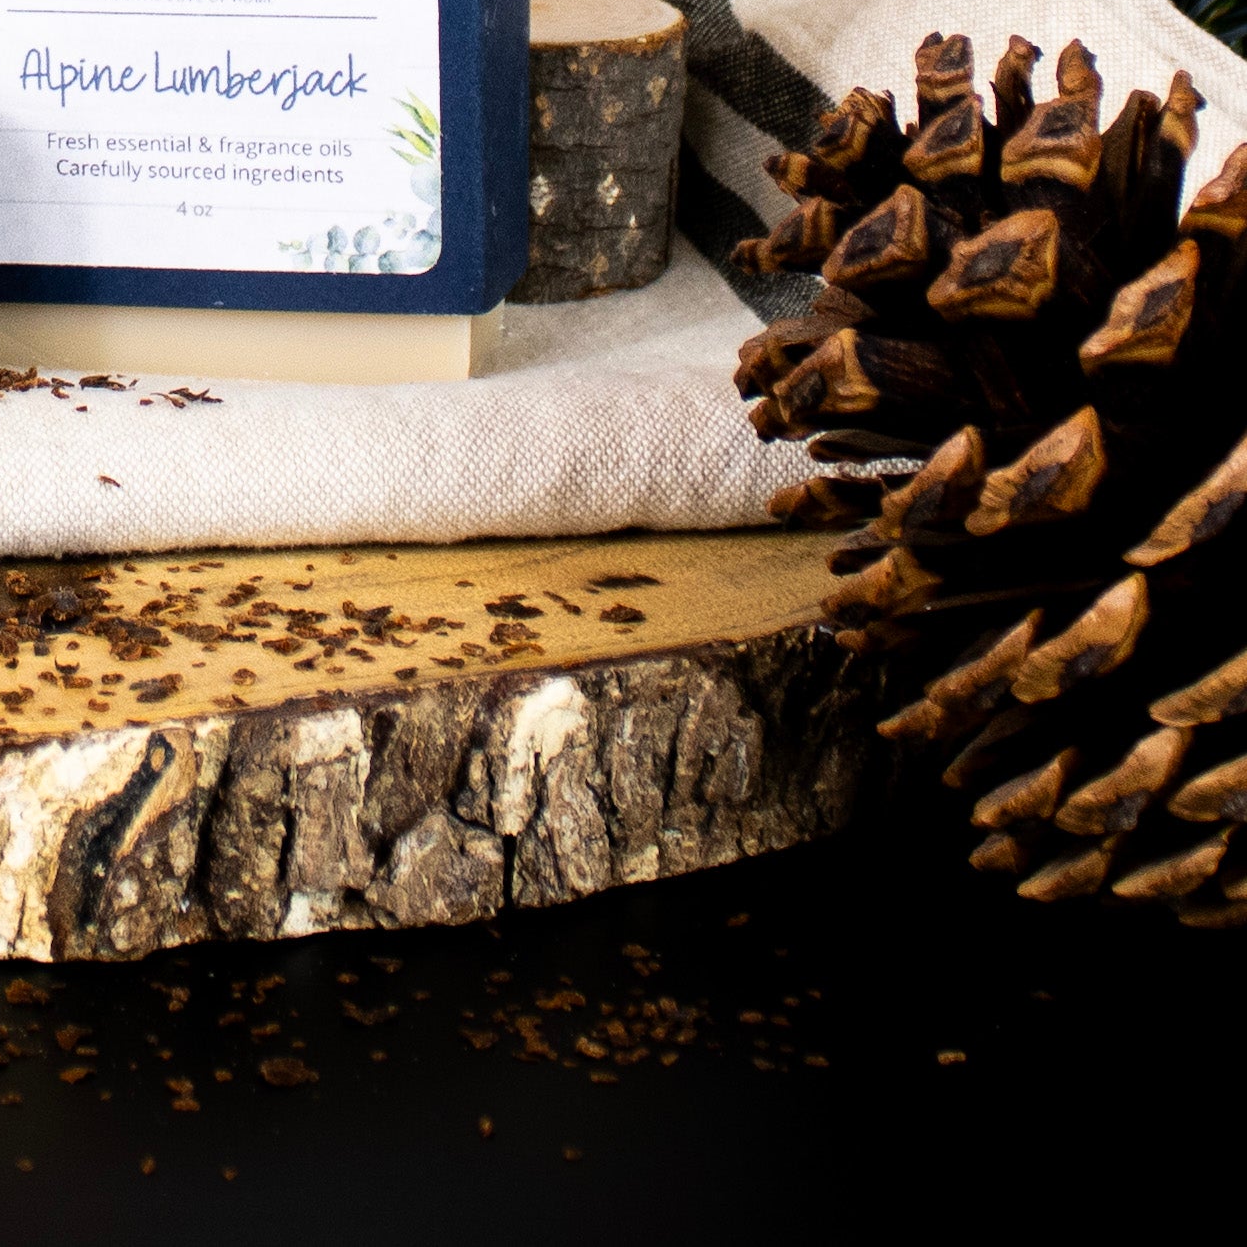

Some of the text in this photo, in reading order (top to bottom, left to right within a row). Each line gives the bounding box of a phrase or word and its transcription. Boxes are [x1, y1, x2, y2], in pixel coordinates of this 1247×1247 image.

[20, 47, 368, 111] Alpine Lumberjack
[47, 133, 352, 160] Fresh essential & fragrance oils
[56, 159, 343, 187] Carefully sourced ingredients
[177, 202, 213, 217] 4 oz
